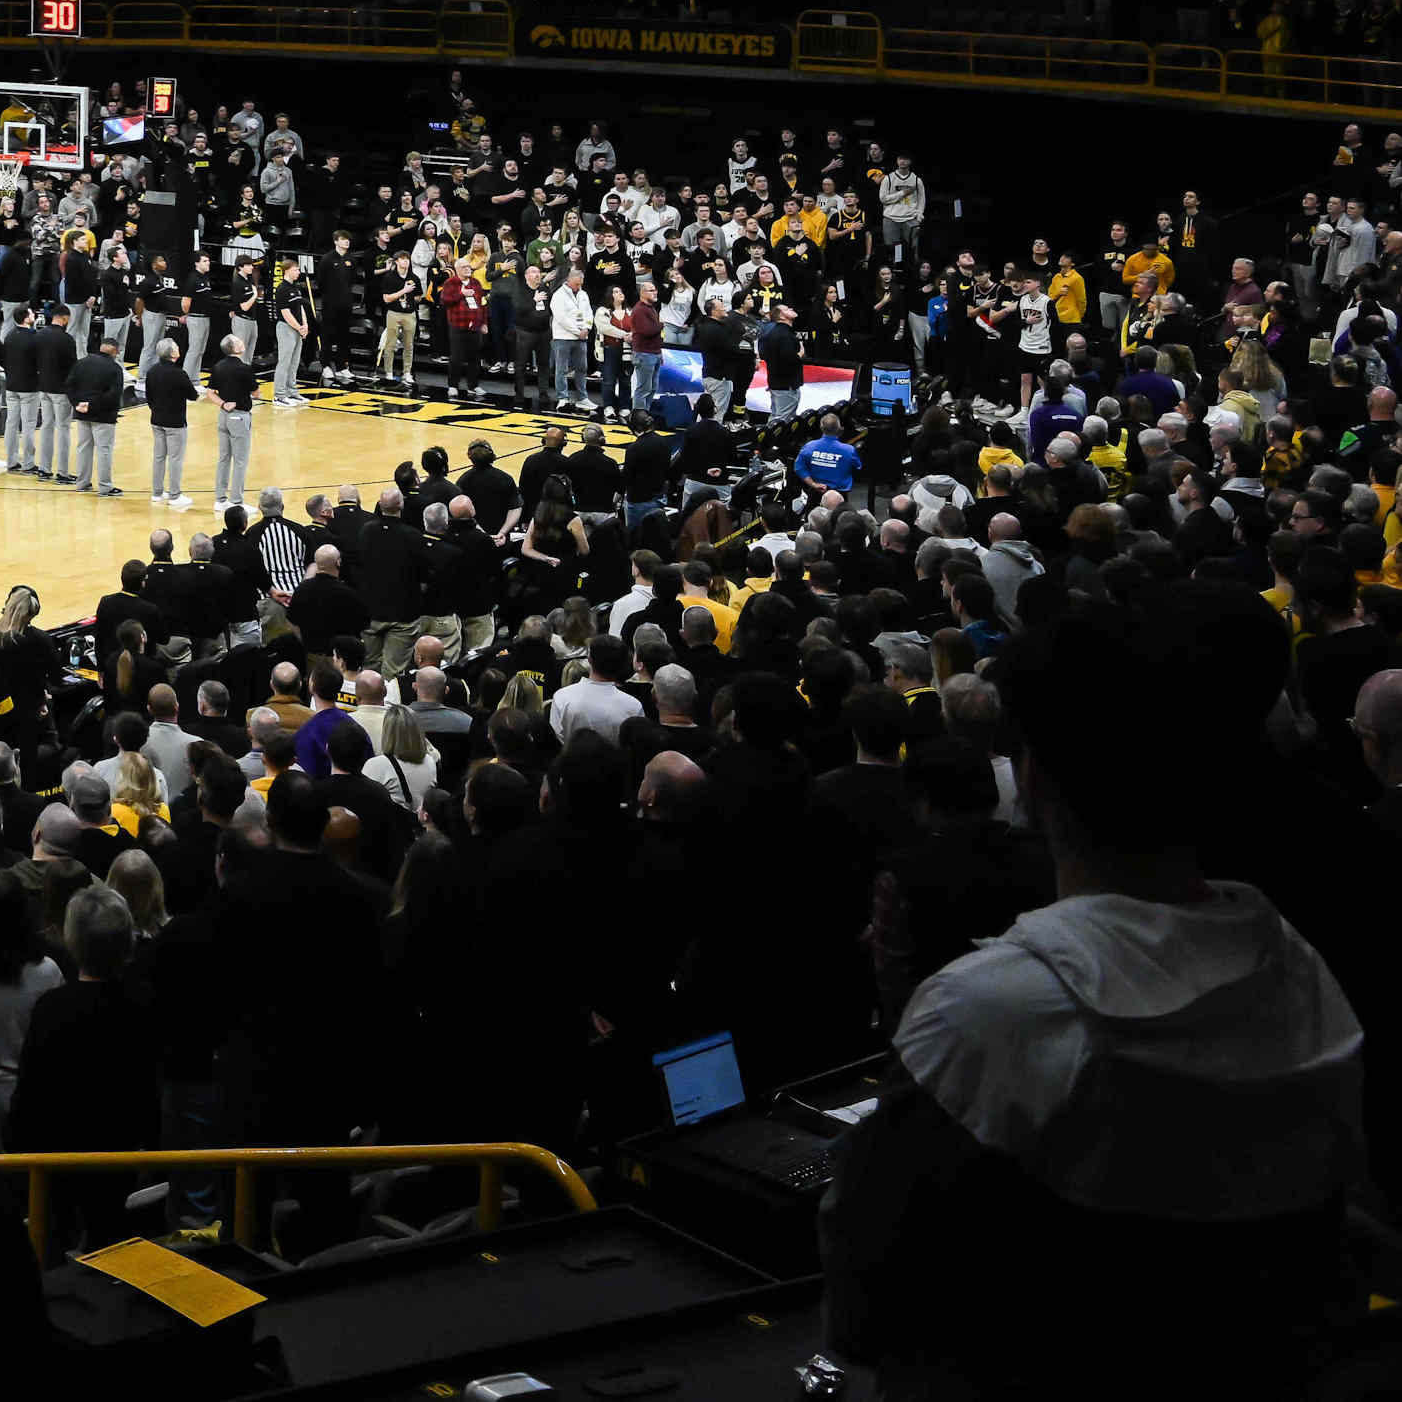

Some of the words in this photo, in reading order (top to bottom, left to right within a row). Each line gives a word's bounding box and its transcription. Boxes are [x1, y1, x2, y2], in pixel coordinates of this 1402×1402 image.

[43, 1, 76, 31] 30
[571, 27, 633, 51] IOWA
[639, 29, 776, 58] HAWKEYES
[155, 96, 169, 112] 30
[812, 450, 843, 461] BEST
